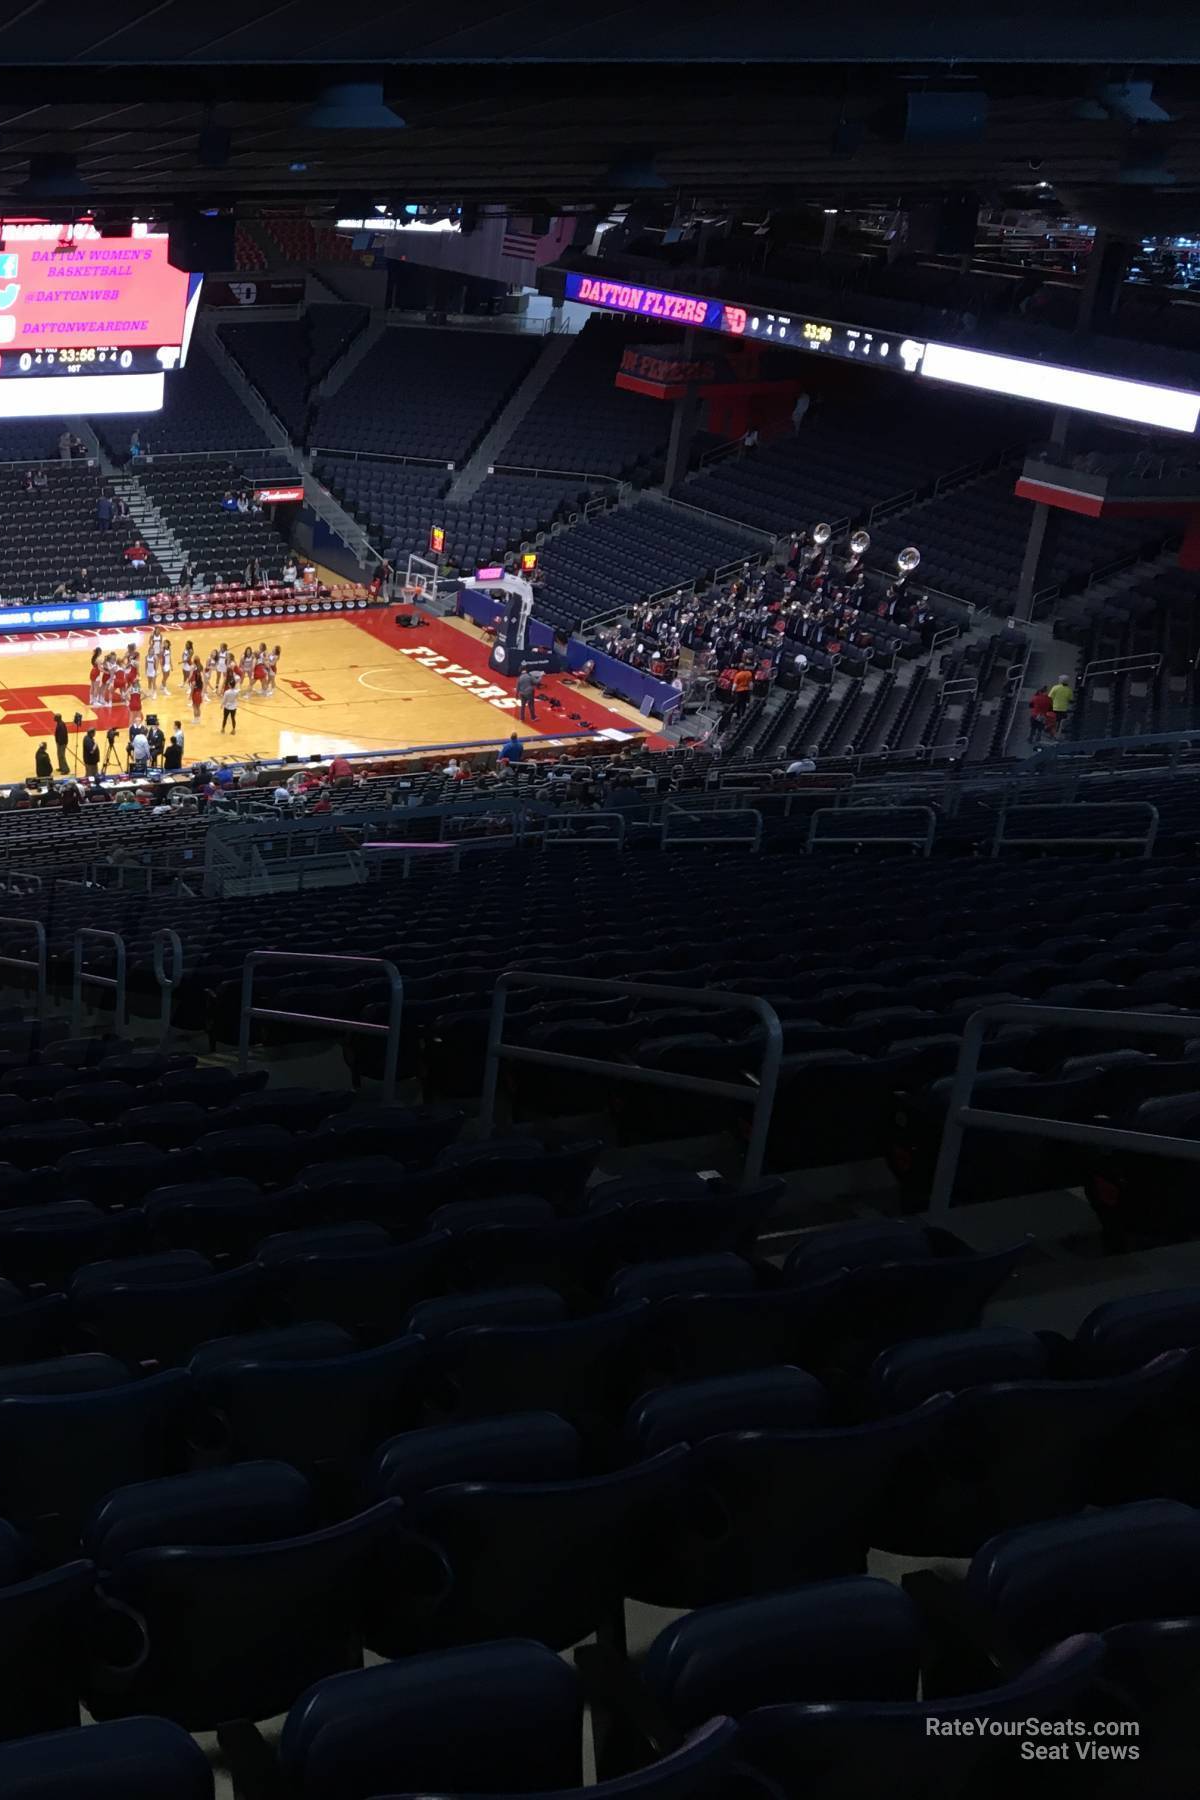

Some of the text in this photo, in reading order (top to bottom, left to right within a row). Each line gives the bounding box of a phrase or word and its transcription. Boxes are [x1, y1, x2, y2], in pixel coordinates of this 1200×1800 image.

[89, 249, 152, 261] WOMEN'S
[47, 265, 133, 277] BASKETBALL
[24, 290, 120, 304] @DAYTONWBB
[579, 279, 709, 323] DAYTON FLYERS
[22, 320, 149, 334] DAYTONWEAREONE
[20, 353, 31, 370] 0
[35, 354, 42, 364] 4
[47, 354, 54, 364] 0
[99, 352, 106, 362] 0
[120, 350, 132, 367] 0
[67, 364, 81, 373] 1ST
[32, 622, 183, 642] DAYTON
[399, 646, 522, 709] FLYERS
